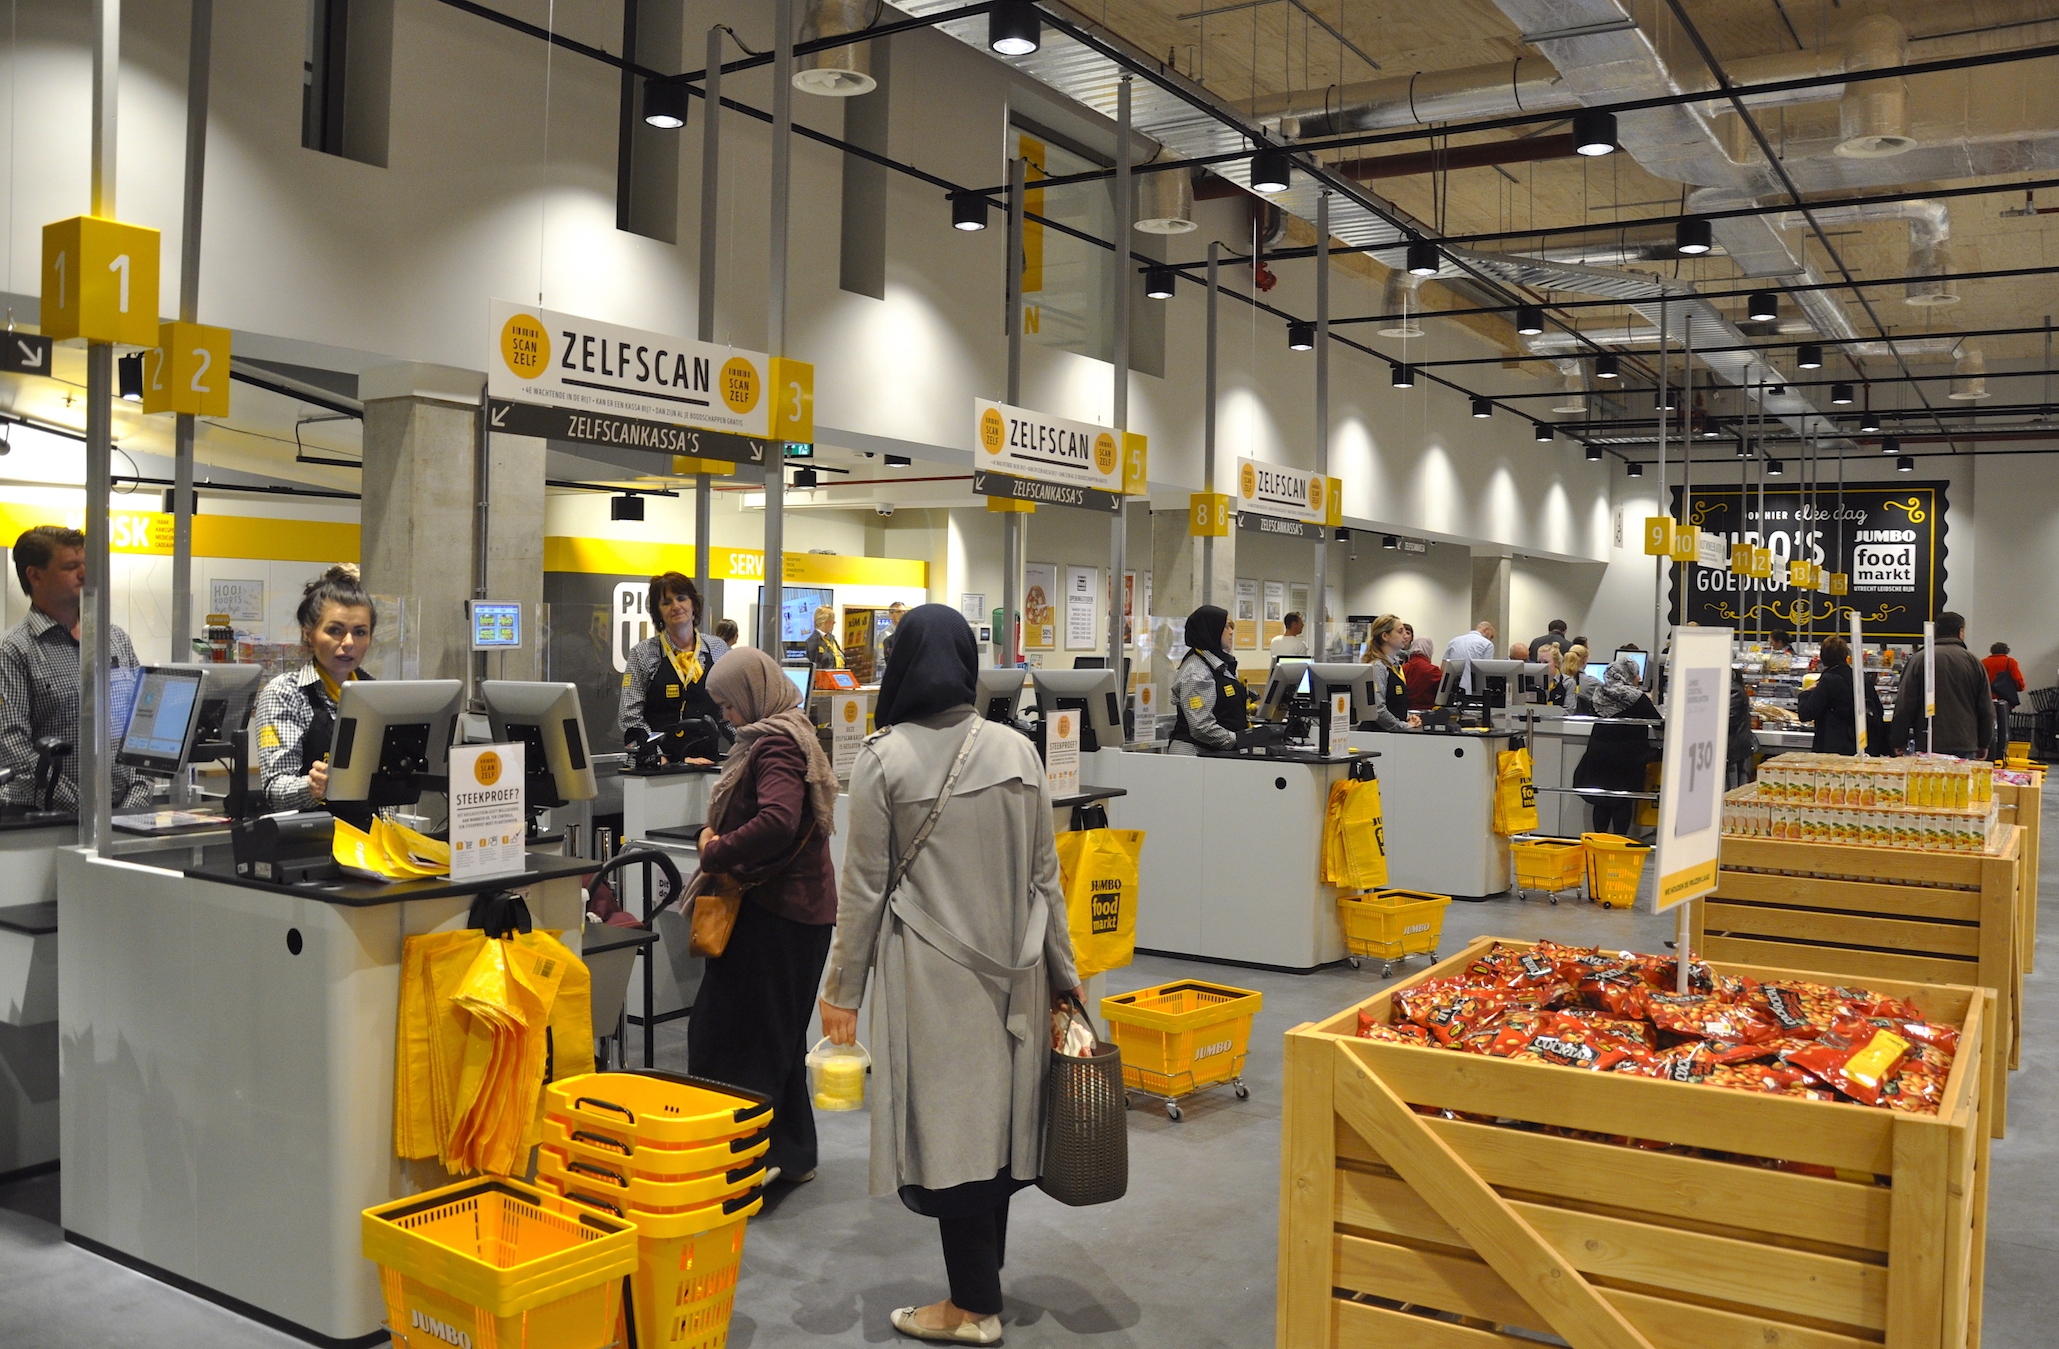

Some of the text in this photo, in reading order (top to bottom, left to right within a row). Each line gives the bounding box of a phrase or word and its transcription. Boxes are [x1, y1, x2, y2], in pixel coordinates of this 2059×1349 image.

[54, 250, 66, 309] 1
[108, 254, 130, 313] 1
[513, 338, 537, 353] SCAN
[513, 352, 537, 366] ZELF
[561, 330, 710, 393] ZELFSCAN
[152, 347, 164, 390] 2
[190, 348, 212, 393] 2
[729, 378, 750, 392] SCAN
[730, 390, 750, 403] ZELF
[788, 381, 802, 422] 3
[533, 387, 566, 400] WACHTENDE
[596, 397, 606, 406] KAN
[614, 400, 624, 408] EEN
[625, 401, 641, 411] KASSA
[655, 406, 665, 415] DAN
[666, 408, 677, 417] ZIJN
[690, 412, 726, 424] BOODSCHAPPEN
[727, 417, 743, 426] GRATIS
[567, 415, 700, 453] ZELFSCANKASSA'S
[986, 425, 998, 436] SCAN
[1010, 418, 1089, 460] ZELFSCAN
[986, 436, 998, 446] ZELF
[1099, 449, 1111, 457] SCAN
[1100, 457, 1111, 466] ZELF
[1132, 450, 1141, 480] 5
[1012, 480, 1084, 505] ZELFSCANKASSA'S
[1258, 470, 1306, 499] ZELFSCAN
[1333, 490, 1339, 514] 7
[1196, 504, 1208, 526] 8
[1218, 504, 1225, 526] 8
[1764, 511, 1788, 520] HIER
[1833, 503, 1868, 526] dag
[1260, 518, 1304, 536] ZELFSCANKASSA'S
[1652, 526, 1663, 546] 9
[1854, 530, 1917, 542] JUMBO
[1675, 534, 1692, 552] 10
[730, 553, 764, 576] SERV
[1735, 551, 1749, 566] 11
[1857, 548, 1911, 566] food
[1792, 567, 1805, 580] 13
[1858, 568, 1911, 580] markt
[214, 585, 242, 597] HOOI
[1832, 579, 1844, 590] 15
[1050, 740, 1077, 750] STEEKPROEF?
[456, 788, 520, 806] STEEKPROEF?
[1090, 879, 1122, 892] JUMBO
[1092, 896, 1119, 917] food
[1093, 917, 1117, 932] markt
[1403, 922, 1430, 936] JUMBO
[1194, 1039, 1233, 1062] JUMBO
[411, 1309, 472, 1349] JUMBO
